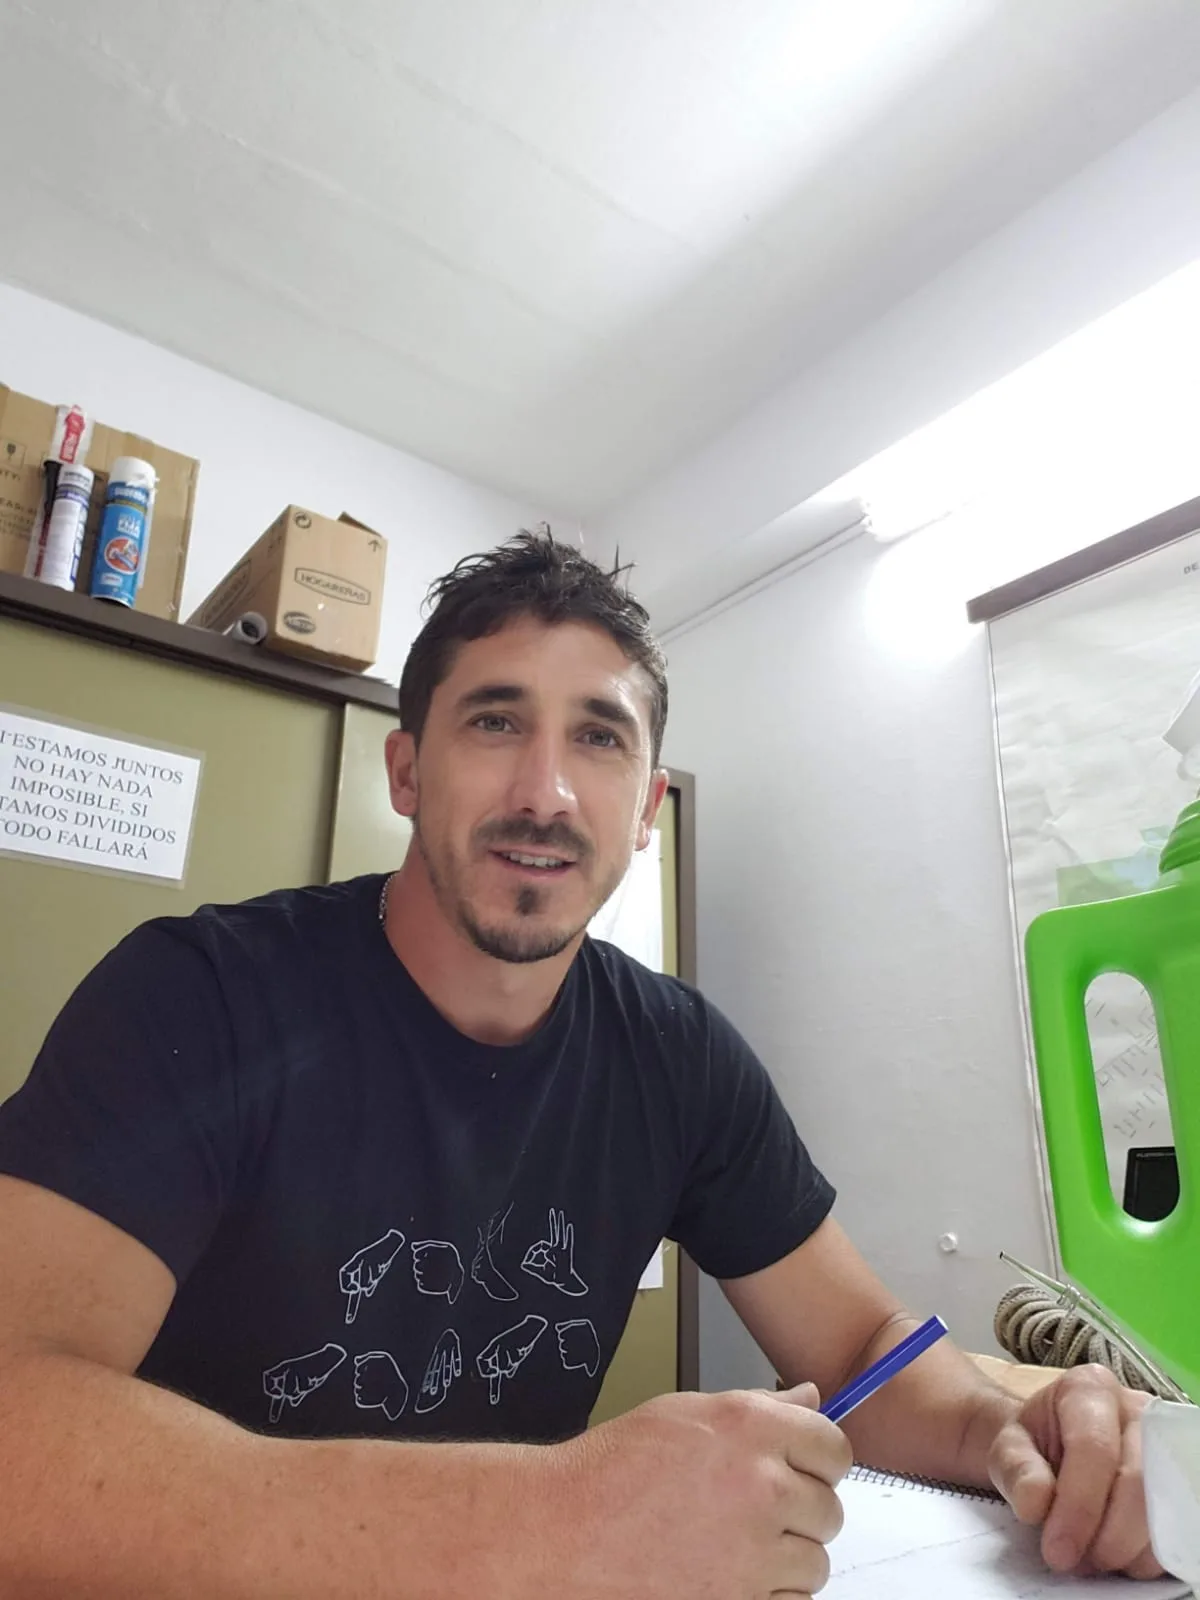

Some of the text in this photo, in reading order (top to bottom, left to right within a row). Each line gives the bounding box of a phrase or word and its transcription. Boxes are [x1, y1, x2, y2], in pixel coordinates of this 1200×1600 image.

[12, 732, 108, 768] ESTAMOS
[112, 756, 184, 785] JUNTOS
[14, 754, 153, 799] NO HAY NADA
[10, 776, 148, 818] IMPOSIBLE, SI
[57, 829, 148, 860] FALLARÁ
[74, 811, 177, 845] DIVIDIDOS
